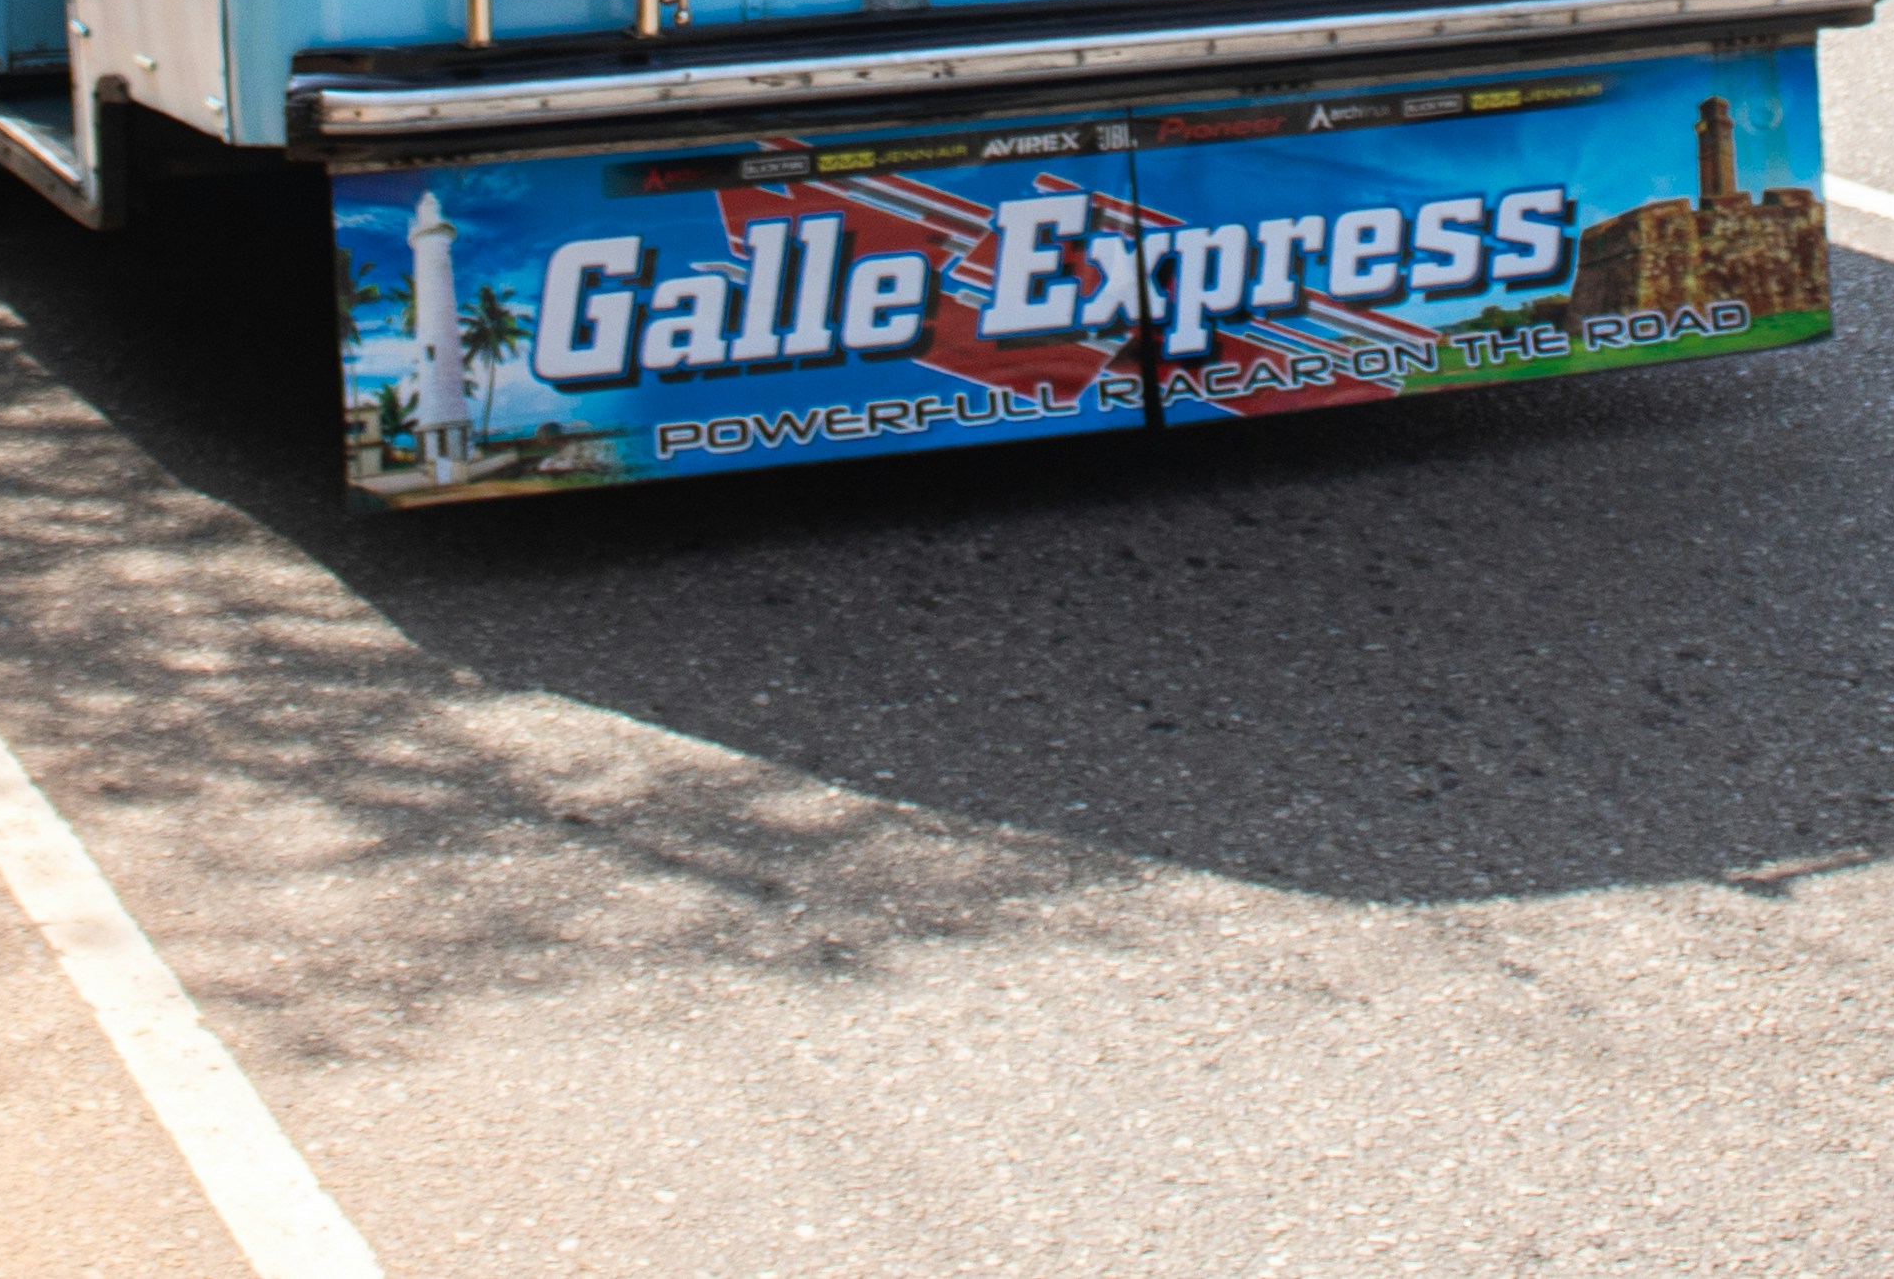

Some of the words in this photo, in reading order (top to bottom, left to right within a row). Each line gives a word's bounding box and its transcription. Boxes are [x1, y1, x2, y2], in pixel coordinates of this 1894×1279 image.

[982, 131, 1081, 159] AVIREX
[1158, 115, 1286, 143] Pioneer
[530, 211, 932, 387] Galle
[979, 184, 1569, 360] Express
[655, 381, 1080, 461] POWERFULL
[1350, 340, 1439, 381] ON
[1454, 324, 1569, 369] THE
[1583, 300, 1751, 351] ROAD
